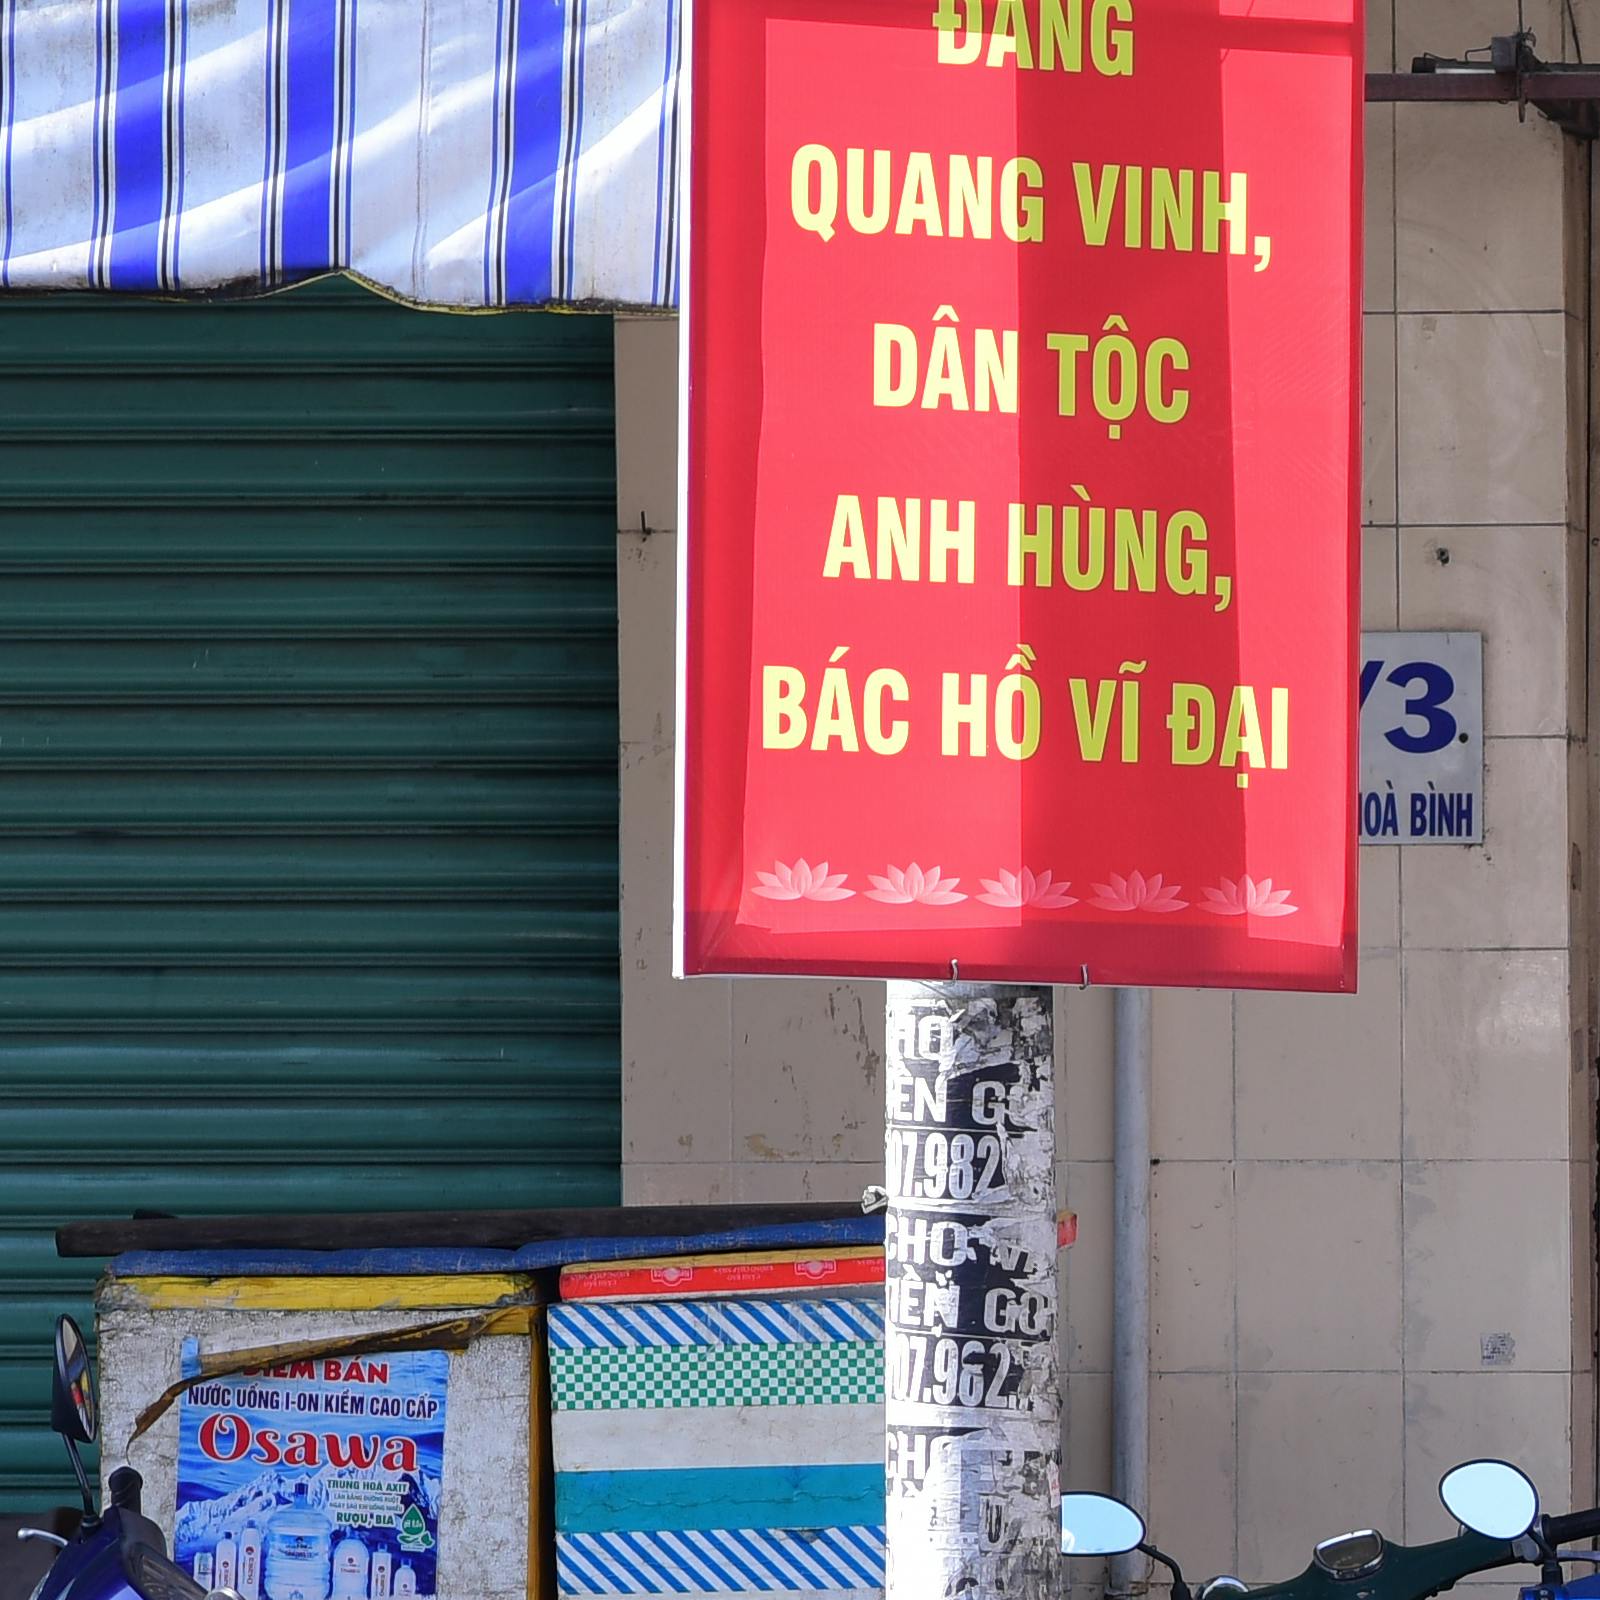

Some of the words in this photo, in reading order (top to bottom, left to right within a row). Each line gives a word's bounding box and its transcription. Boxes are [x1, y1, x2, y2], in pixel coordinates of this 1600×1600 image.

[790, 143, 1045, 244] QUANG
[1072, 161, 1273, 272] VINH,
[873, 305, 1019, 414] DÂN
[1046, 315, 1191, 440] TỘC
[822, 494, 976, 585] ANH
[1006, 485, 1233, 612] HÙNG,
[761, 646, 910, 756] BÁC
[941, 643, 1040, 761] HỒ
[1069, 659, 1146, 764] VĨ
[1166, 684, 1290, 789] ĐẠI
[1410, 781, 1473, 837] BÌNH
[324, 1355, 388, 1384] BÁN
[188, 1383, 232, 1407] NƯỚC
[237, 1383, 280, 1411] UỐNG
[285, 1391, 319, 1412] I-ON
[370, 1397, 401, 1417] CAO
[406, 1392, 438, 1419] CẤP
[199, 1412, 418, 1473] Osawa
[327, 1479, 360, 1490] TRUNG
[386, 1482, 408, 1493] AXIT
[375, 1514, 394, 1525] BIA
